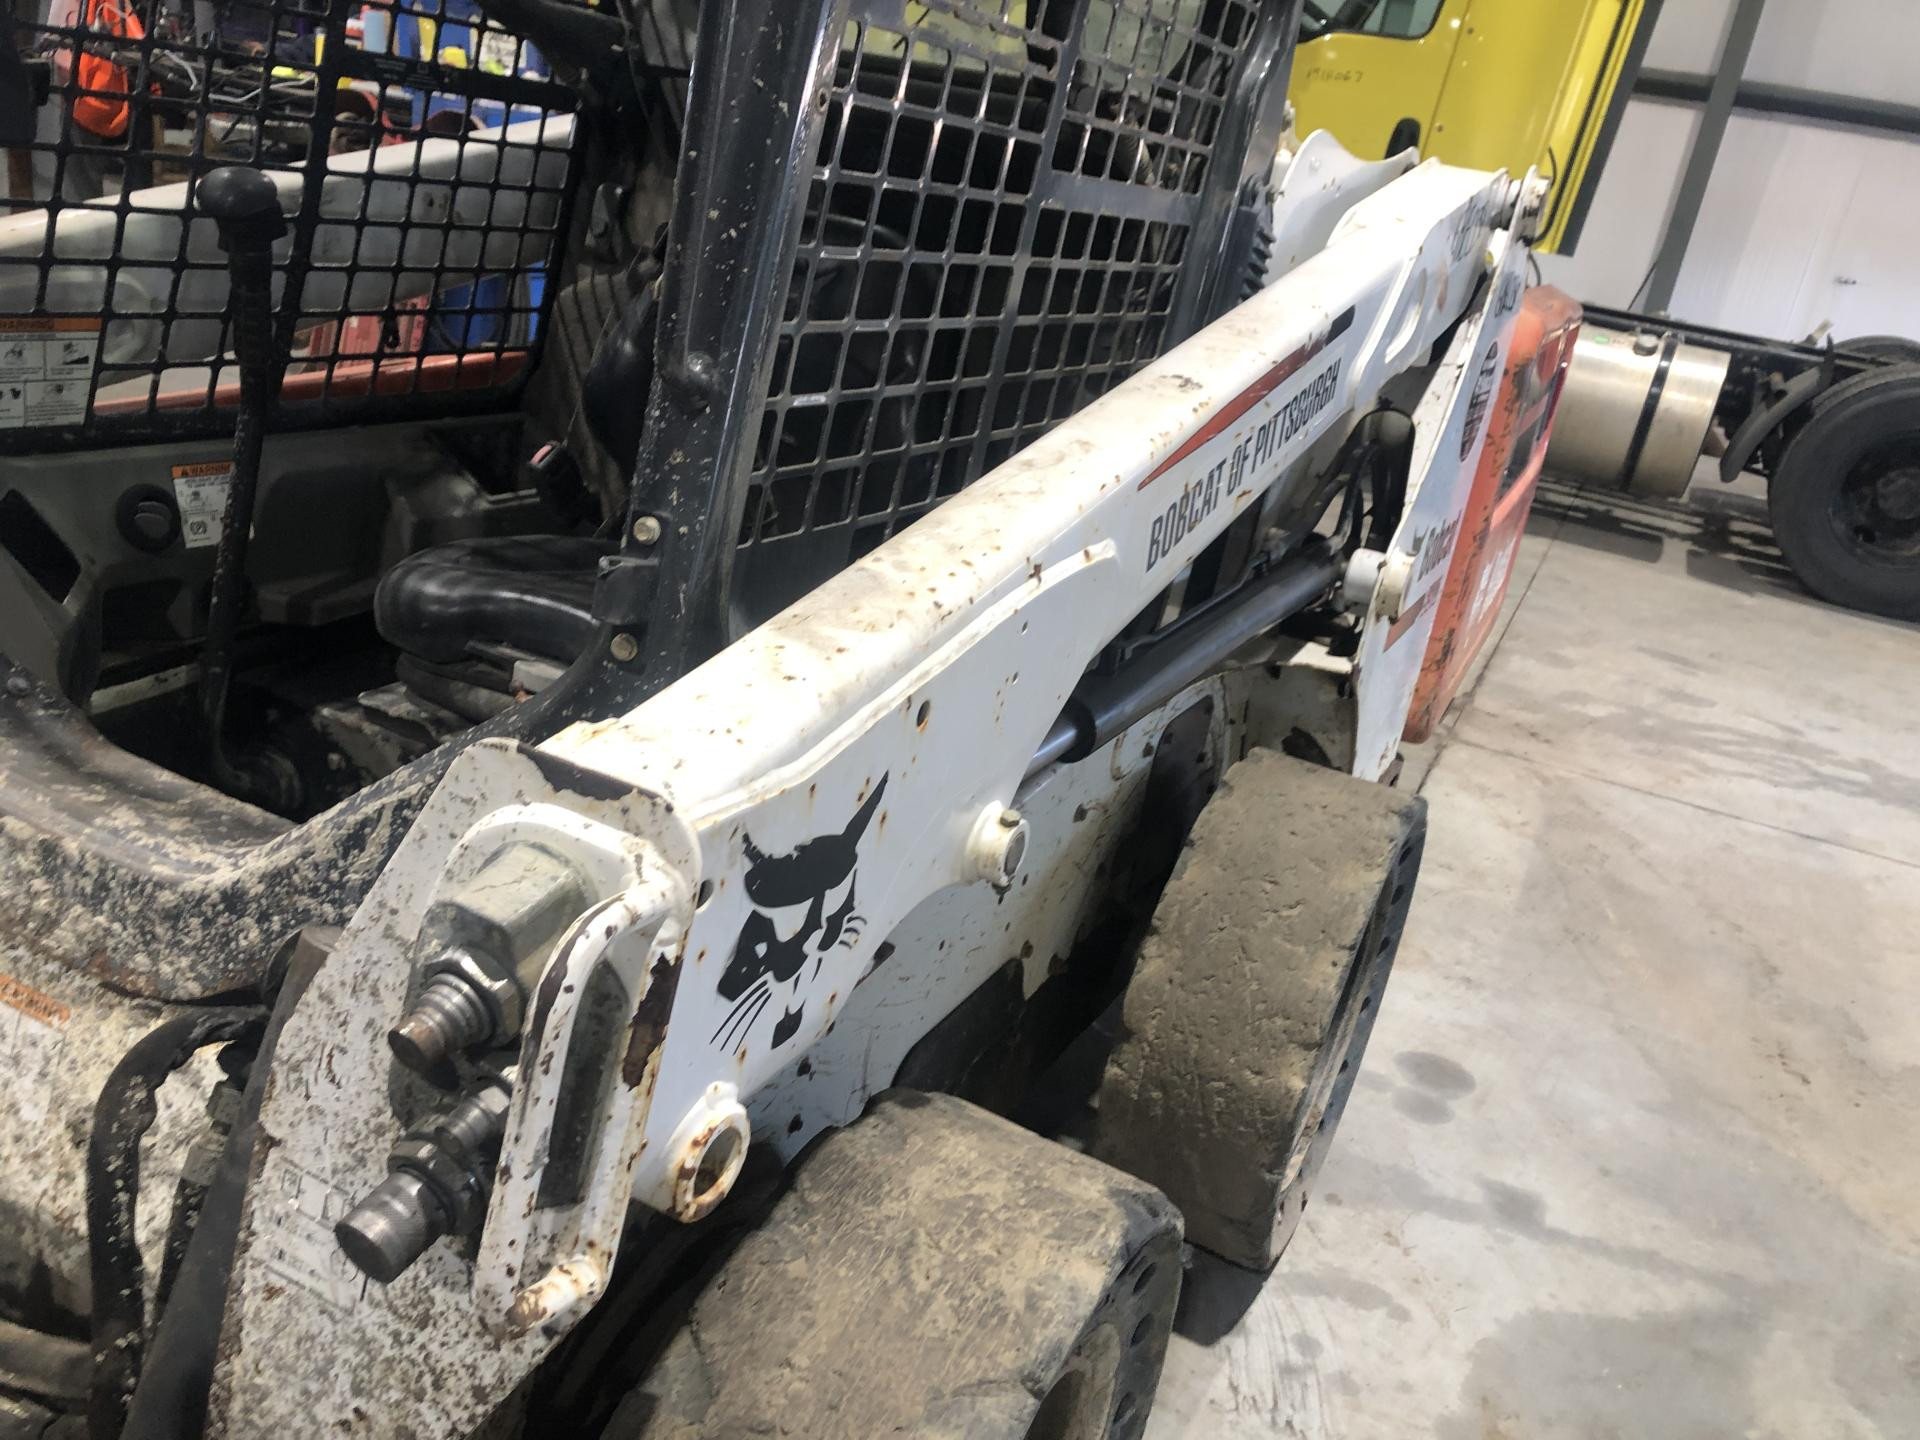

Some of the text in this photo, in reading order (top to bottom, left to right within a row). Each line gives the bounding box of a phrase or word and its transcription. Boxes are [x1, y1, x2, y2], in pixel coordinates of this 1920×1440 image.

[1147, 460, 1227, 573] BOBCAT
[1226, 436, 1253, 496] OF
[1251, 358, 1342, 475] PITTSBURGH
